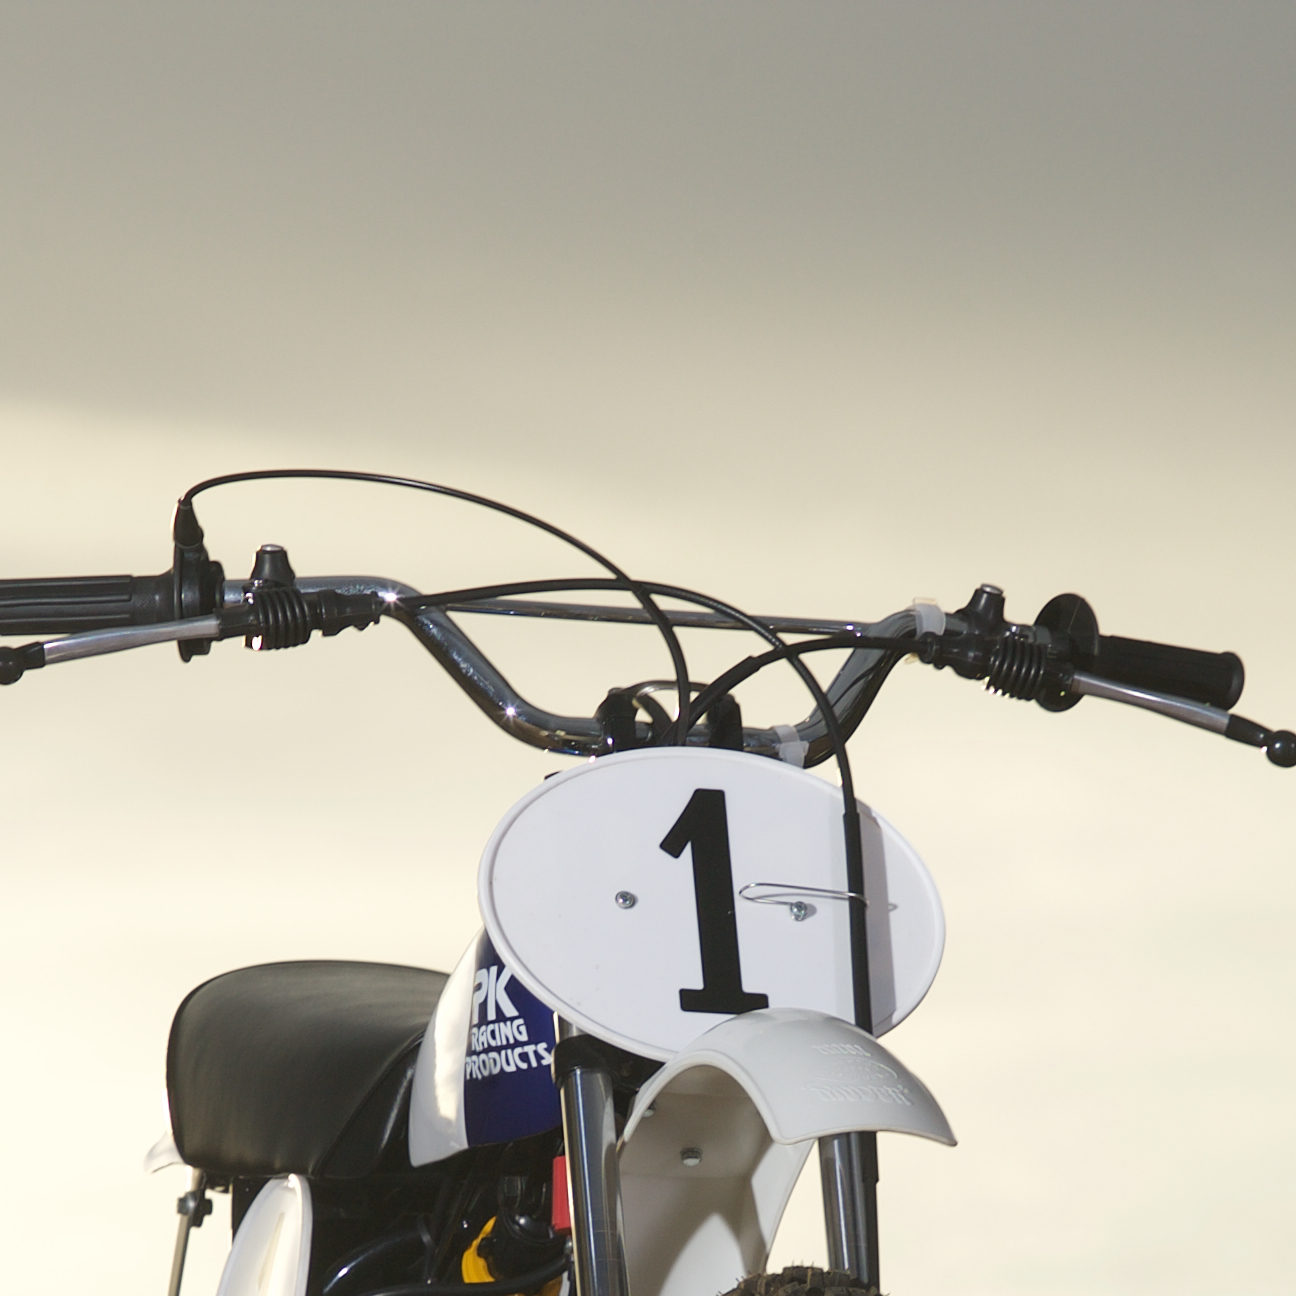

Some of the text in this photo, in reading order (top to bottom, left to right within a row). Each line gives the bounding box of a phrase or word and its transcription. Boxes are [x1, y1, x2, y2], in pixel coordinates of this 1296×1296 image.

[659, 788, 769, 1015] 1
[471, 965, 520, 1024] PK
[470, 1018, 529, 1053] RACING
[465, 1042, 553, 1081] PRODUCTS
